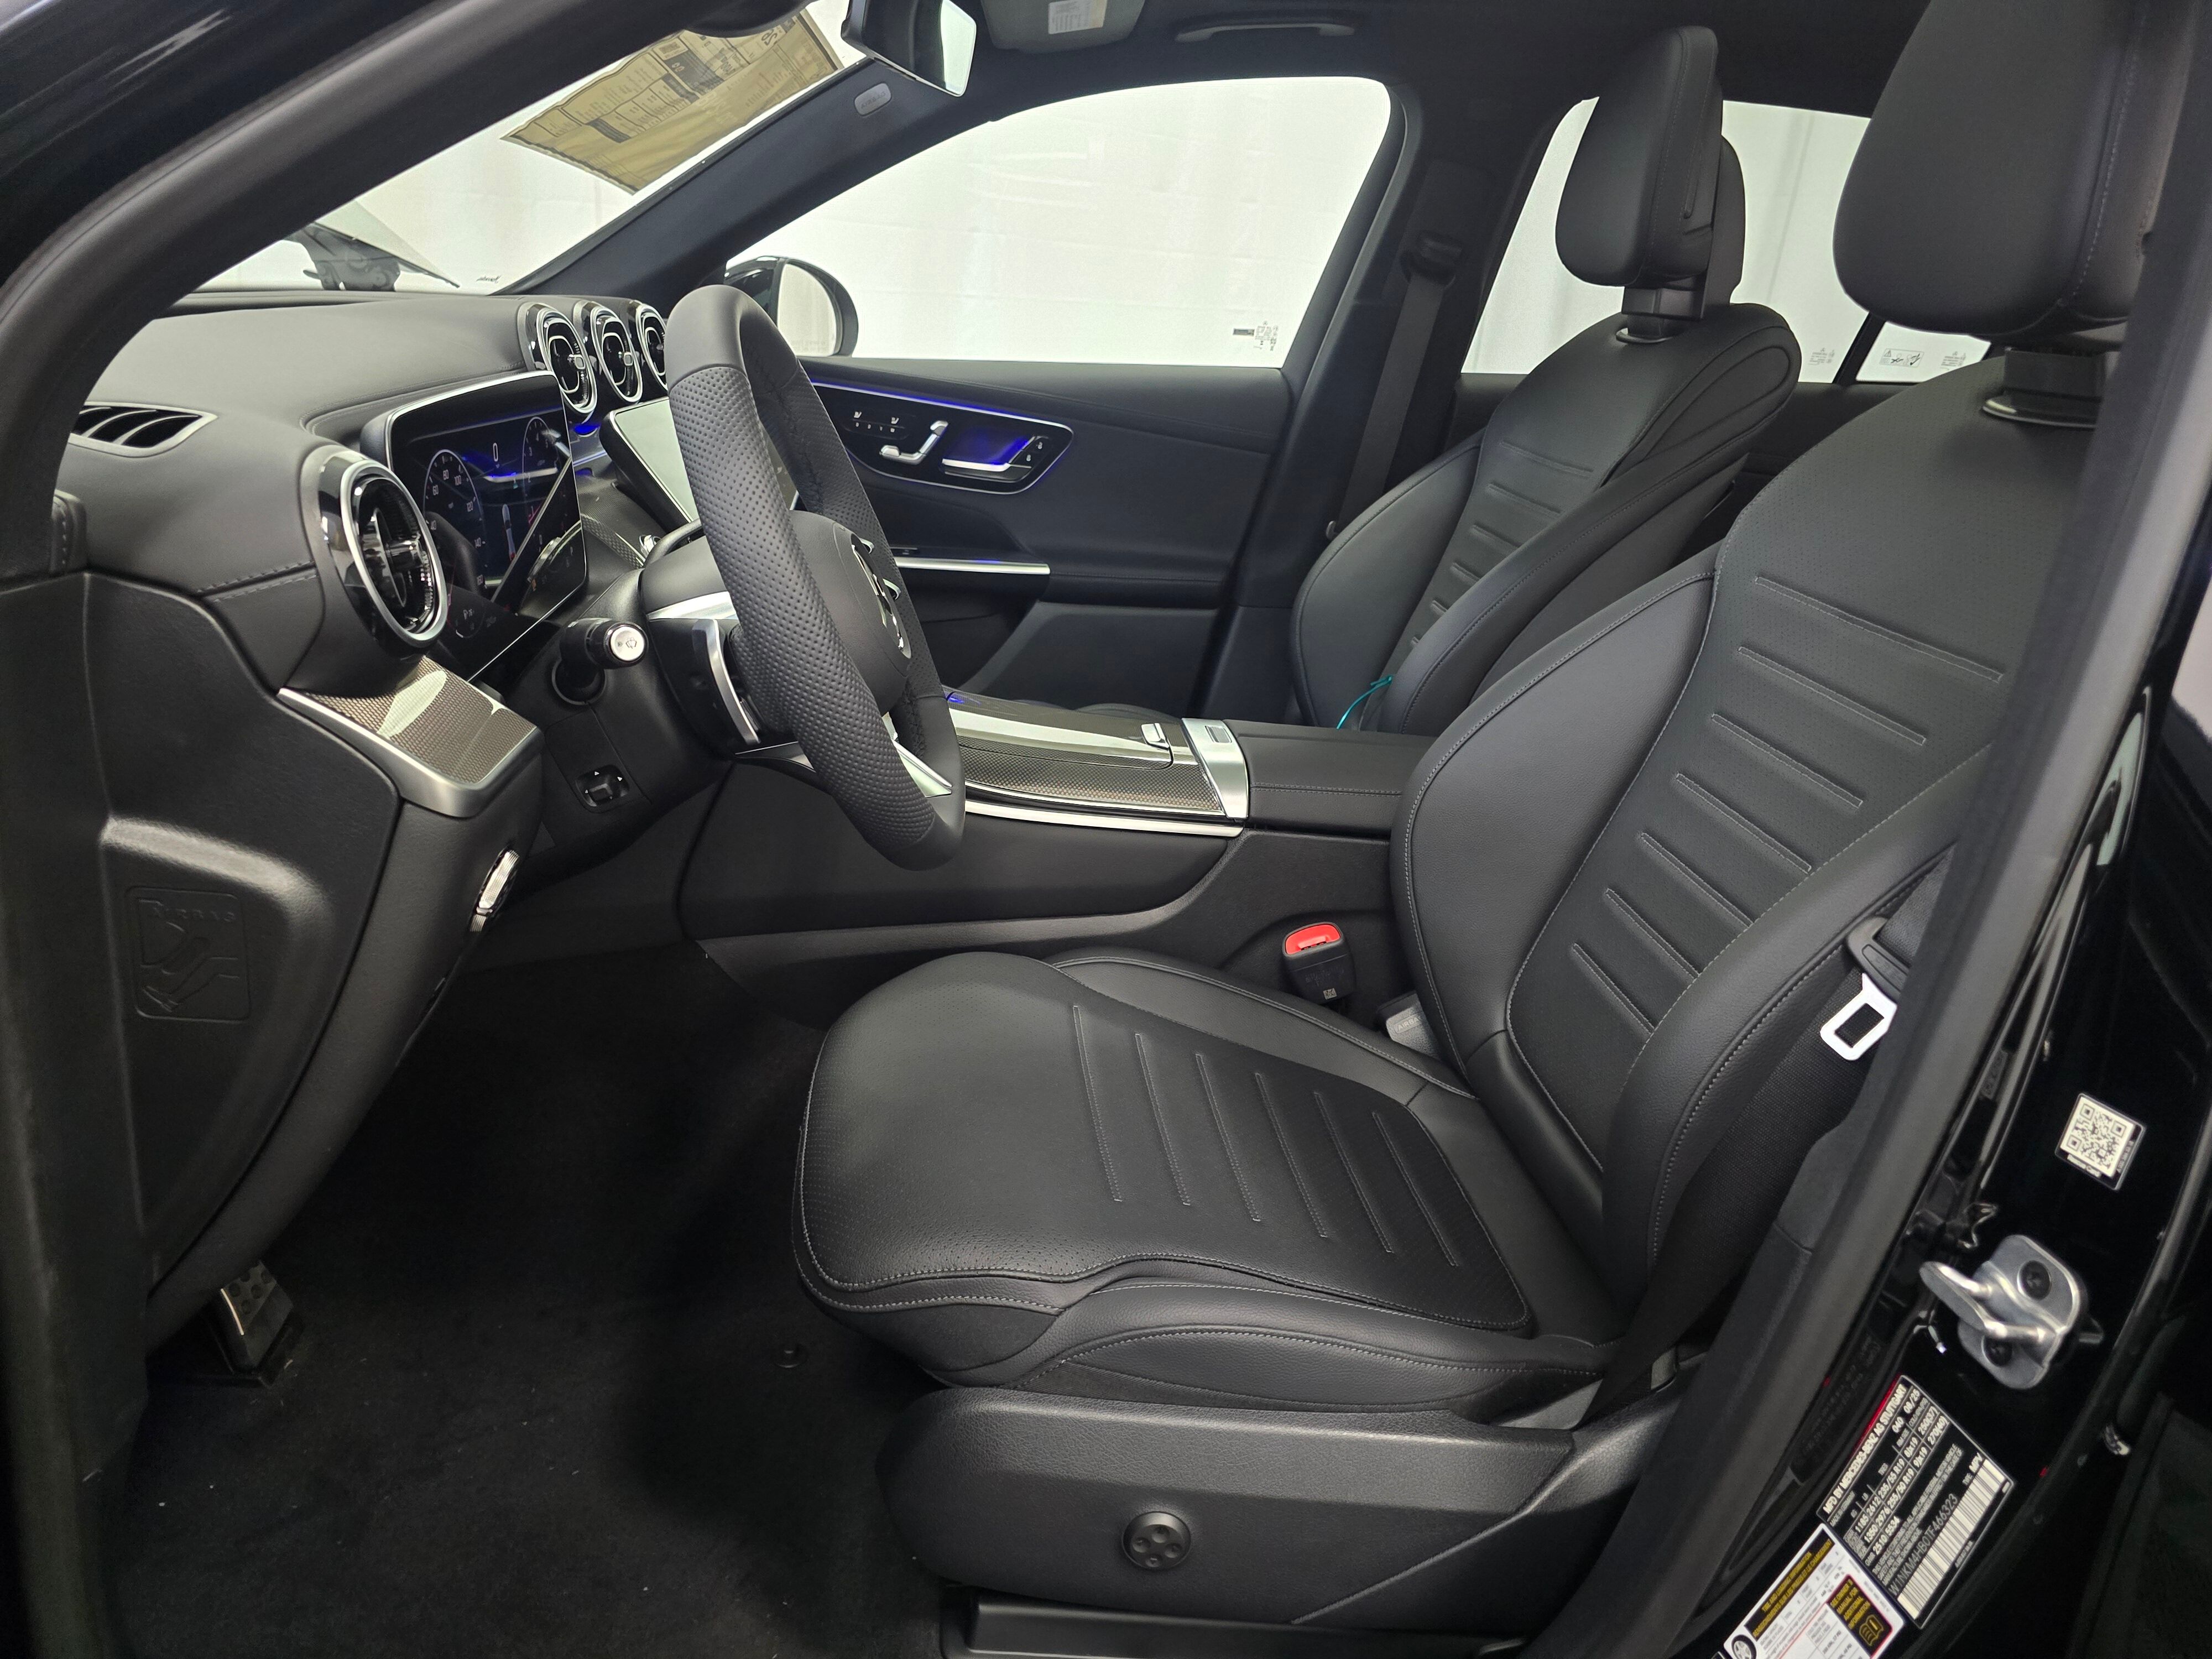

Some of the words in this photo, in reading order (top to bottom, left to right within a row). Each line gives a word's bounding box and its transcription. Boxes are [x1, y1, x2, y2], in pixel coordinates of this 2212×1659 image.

[493, 442, 498, 462] 0
[1878, 1383, 1908, 1427] STUTTGART
[1872, 1420, 1885, 1437] AG
[1890, 1415, 1905, 1434] 040
[1916, 1405, 1939, 1436] 250(37)
[1926, 1414, 1949, 1446] 270(40)
[1839, 1431, 1879, 1491] MERCEDES-BENZ
[1968, 1452, 1984, 1474] MPV
[1877, 1470, 1898, 1500] 235/55
[1892, 1457, 1906, 1475] R19
[1886, 1480, 1908, 1510] 255/50
[1902, 1467, 1915, 1485] R19
[1833, 1485, 1844, 1500] BY
[1822, 1494, 1838, 1515] MFD
[1865, 1495, 1881, 1517] 2612
[1854, 1512, 1869, 1534] 1185
[1875, 1505, 1890, 1527] 2976
[1884, 1514, 1901, 1537] 5534
[1863, 1522, 1879, 1544] 1350
[1872, 1532, 1888, 1555] 2510
